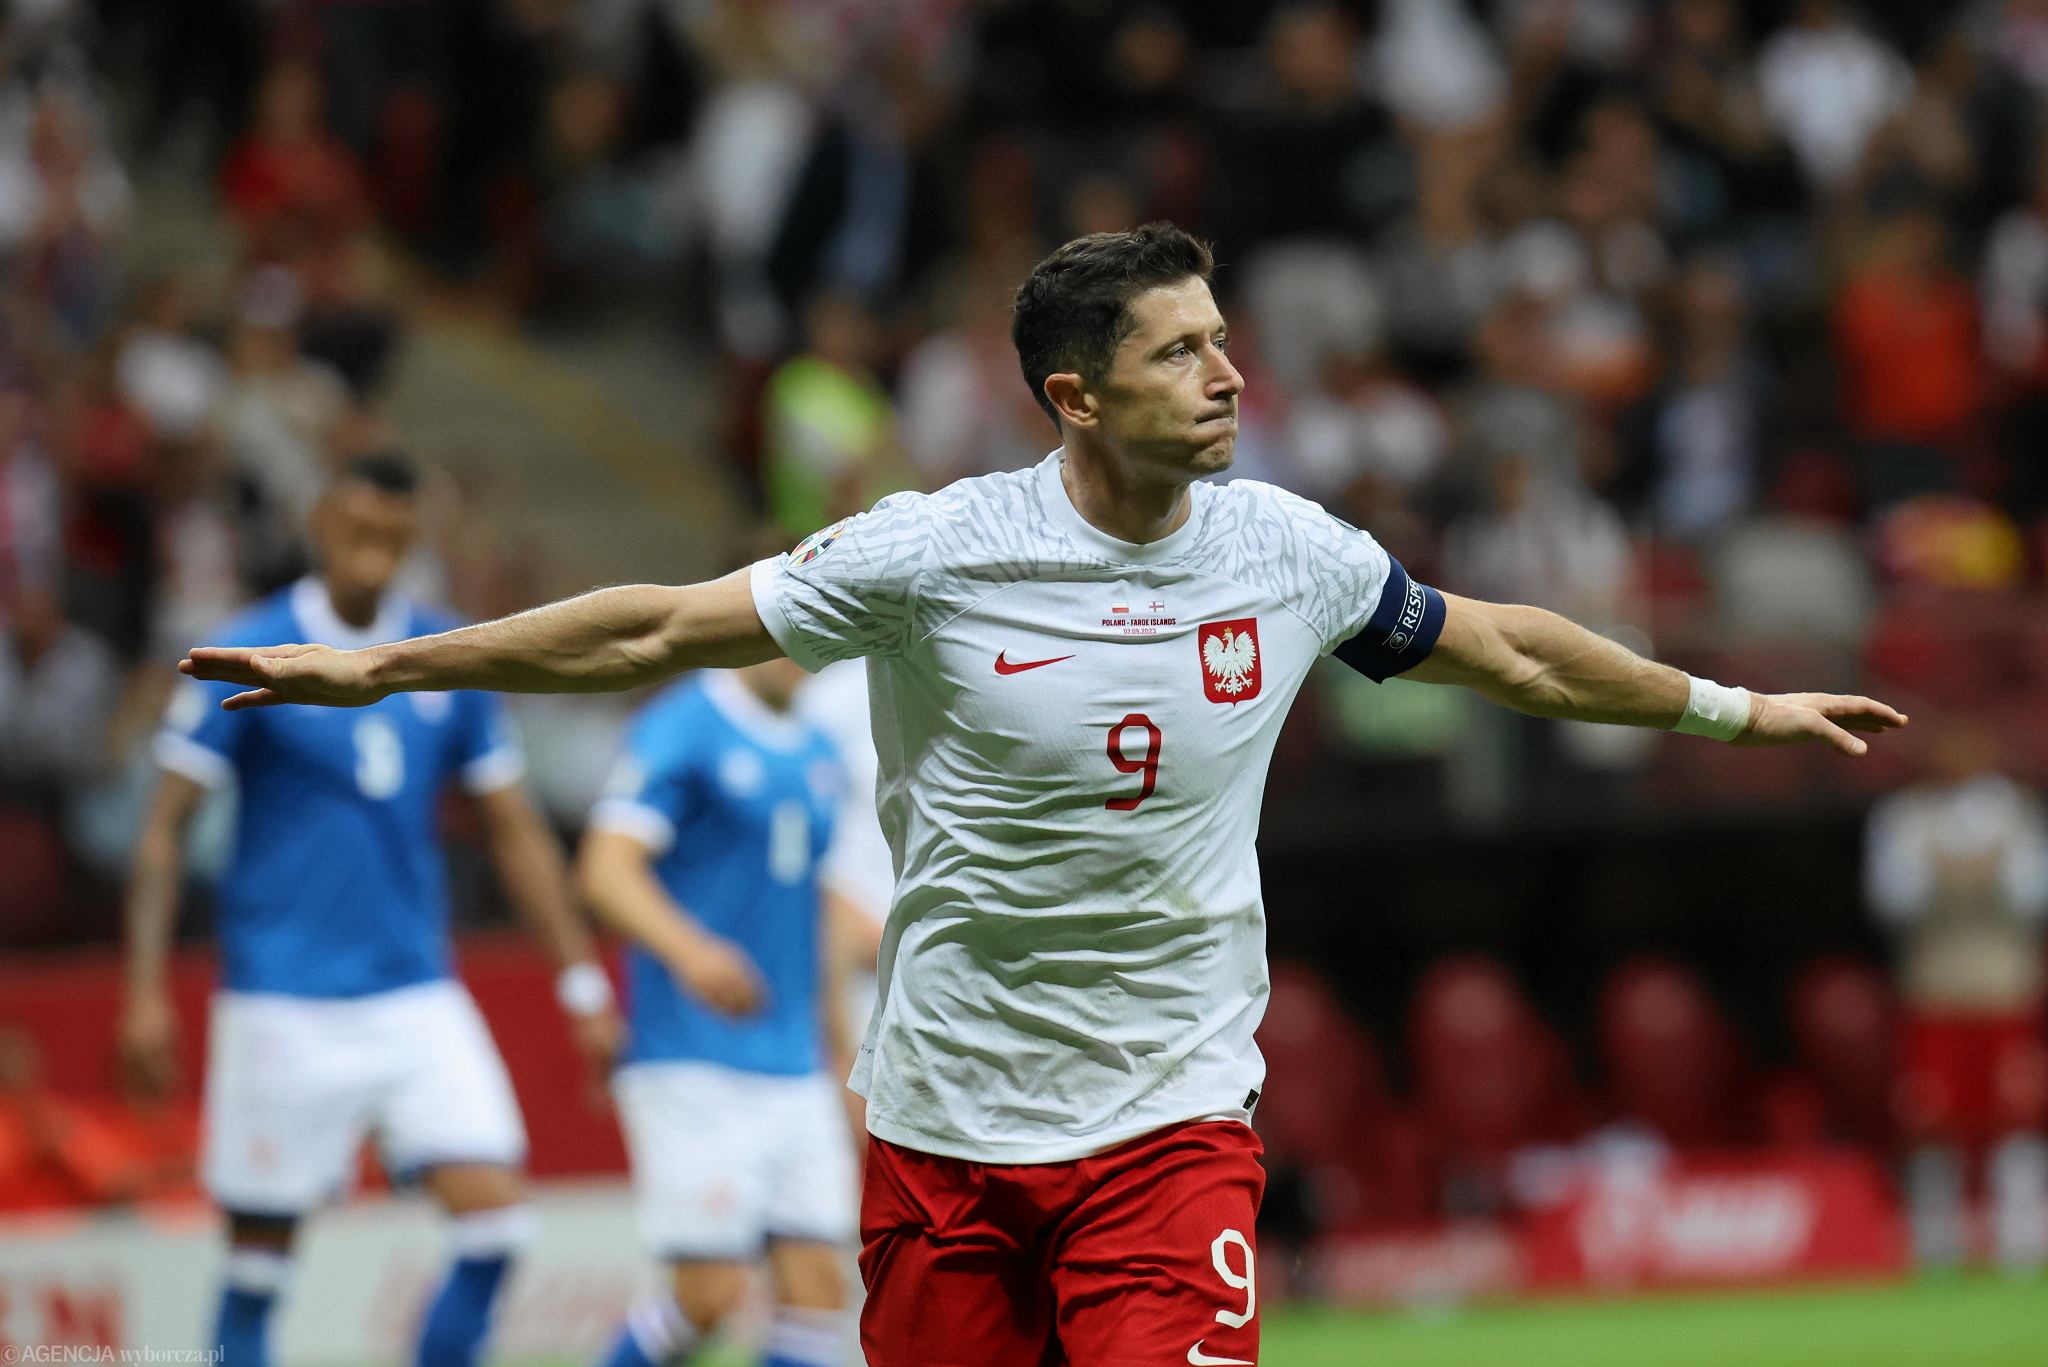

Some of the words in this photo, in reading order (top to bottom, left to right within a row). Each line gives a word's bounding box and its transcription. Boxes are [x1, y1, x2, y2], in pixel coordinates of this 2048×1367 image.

[1102, 619, 1126, 627] POLAND
[1151, 618, 1176, 626] ISLANDS
[1104, 713, 1162, 811] 9
[1211, 1229, 1255, 1328] 9
